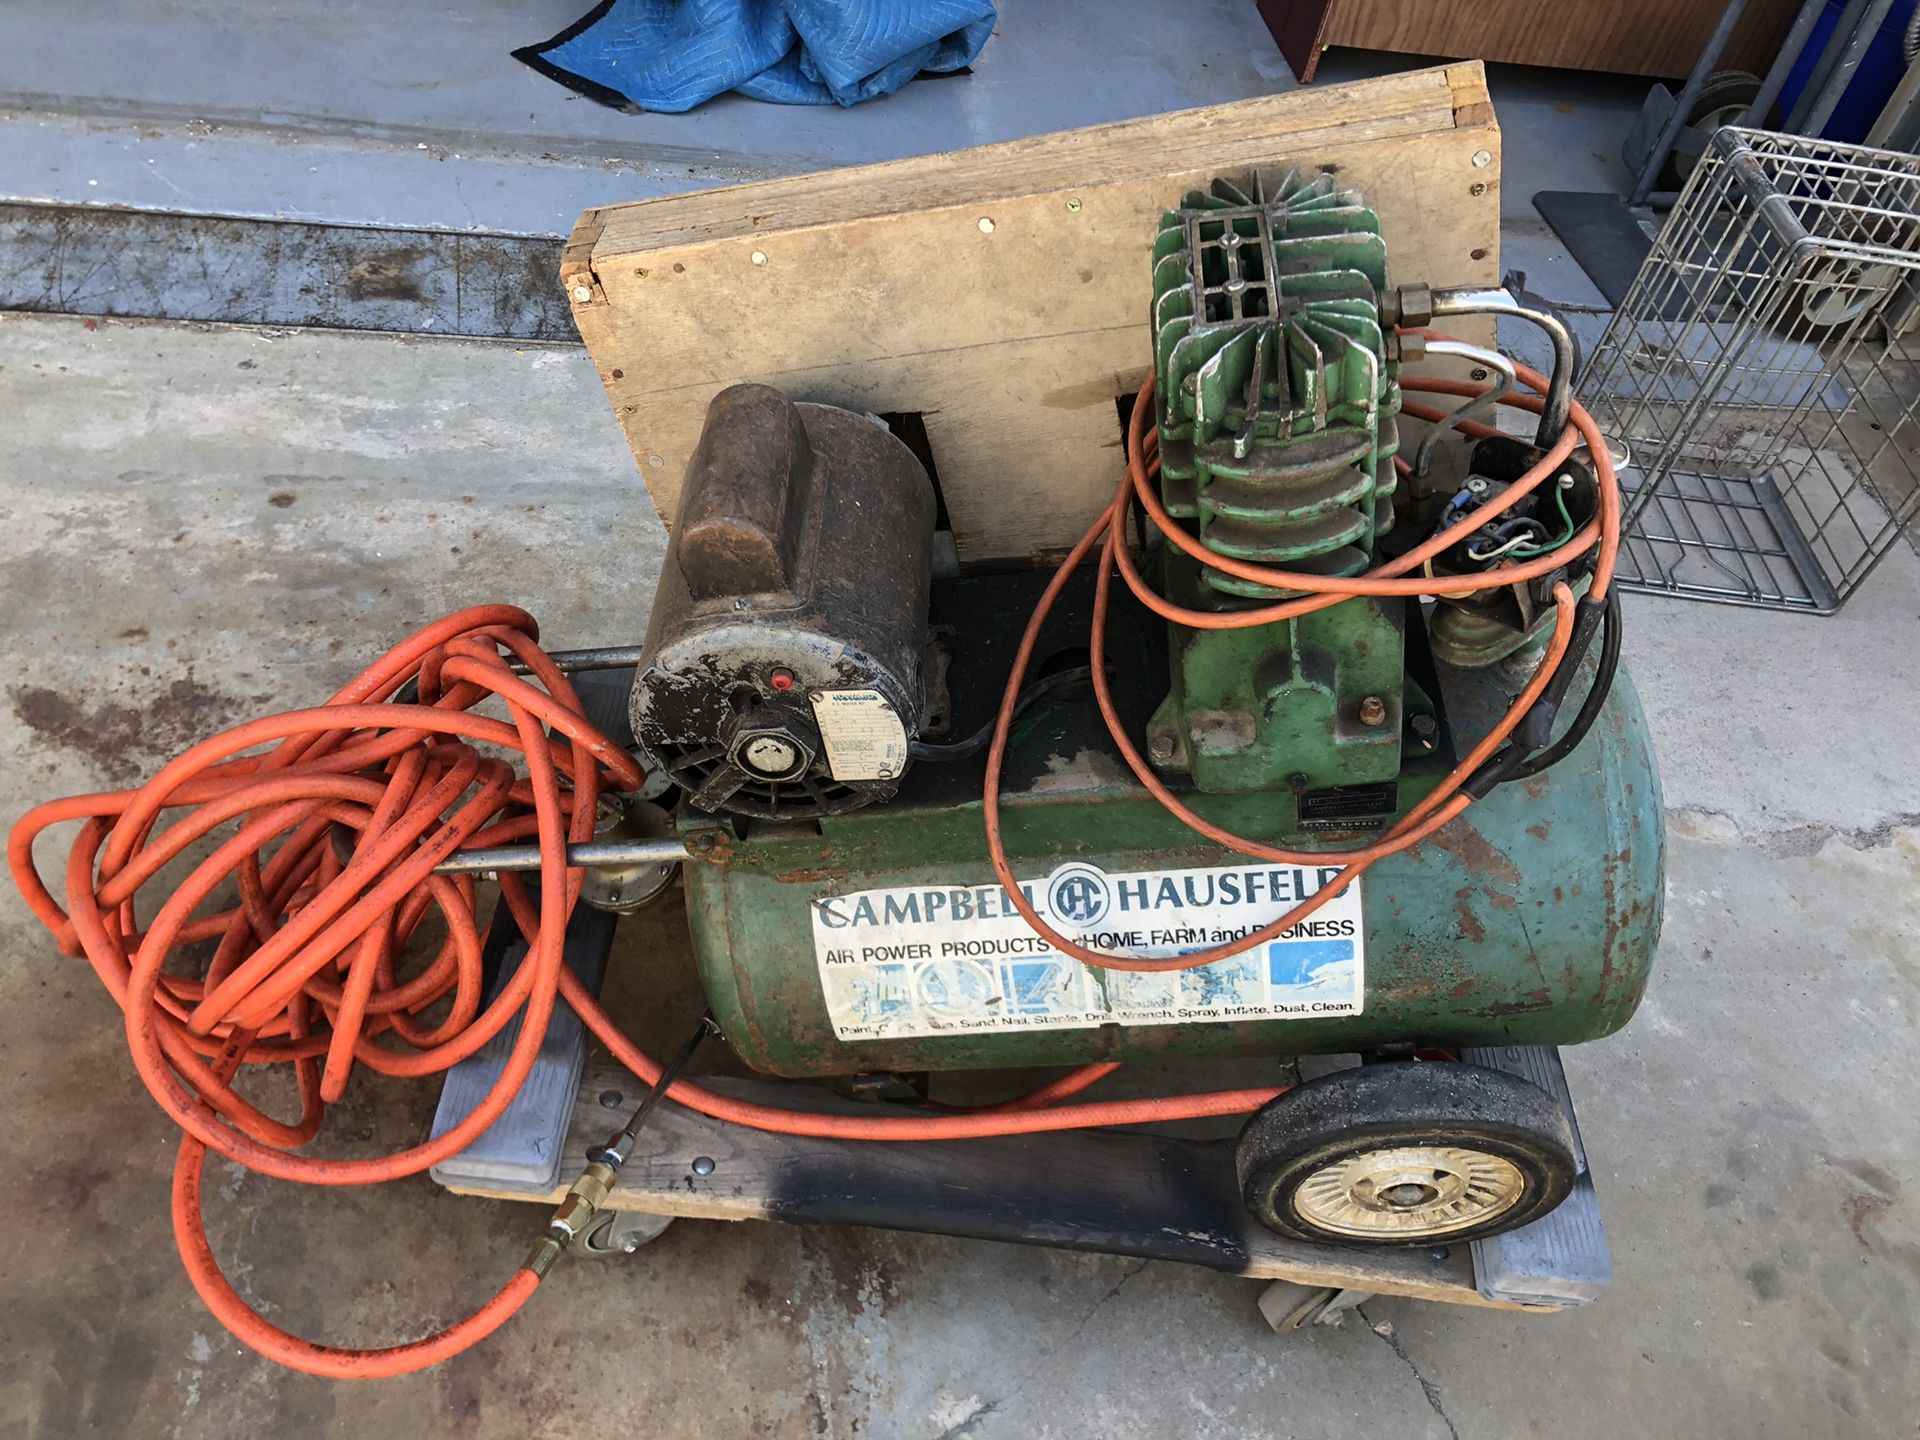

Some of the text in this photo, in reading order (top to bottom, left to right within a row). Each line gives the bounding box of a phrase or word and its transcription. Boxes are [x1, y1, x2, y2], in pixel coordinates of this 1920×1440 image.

[819, 885, 1045, 929] CAMPBELL
[825, 949, 855, 965] AIR
[863, 943, 932, 962] POWER
[941, 937, 1049, 957] PRODUCTS
[1083, 931, 1149, 950] HOME,
[1151, 928, 1206, 945] FARM
[1211, 924, 1246, 942] and
[1252, 919, 1355, 940] SINESS
[1178, 1007, 1220, 1020] Spray,
[1224, 1005, 1270, 1016] Inflate,
[1274, 1003, 1309, 1013] Dust,
[1312, 1001, 1355, 1012] Clean.
